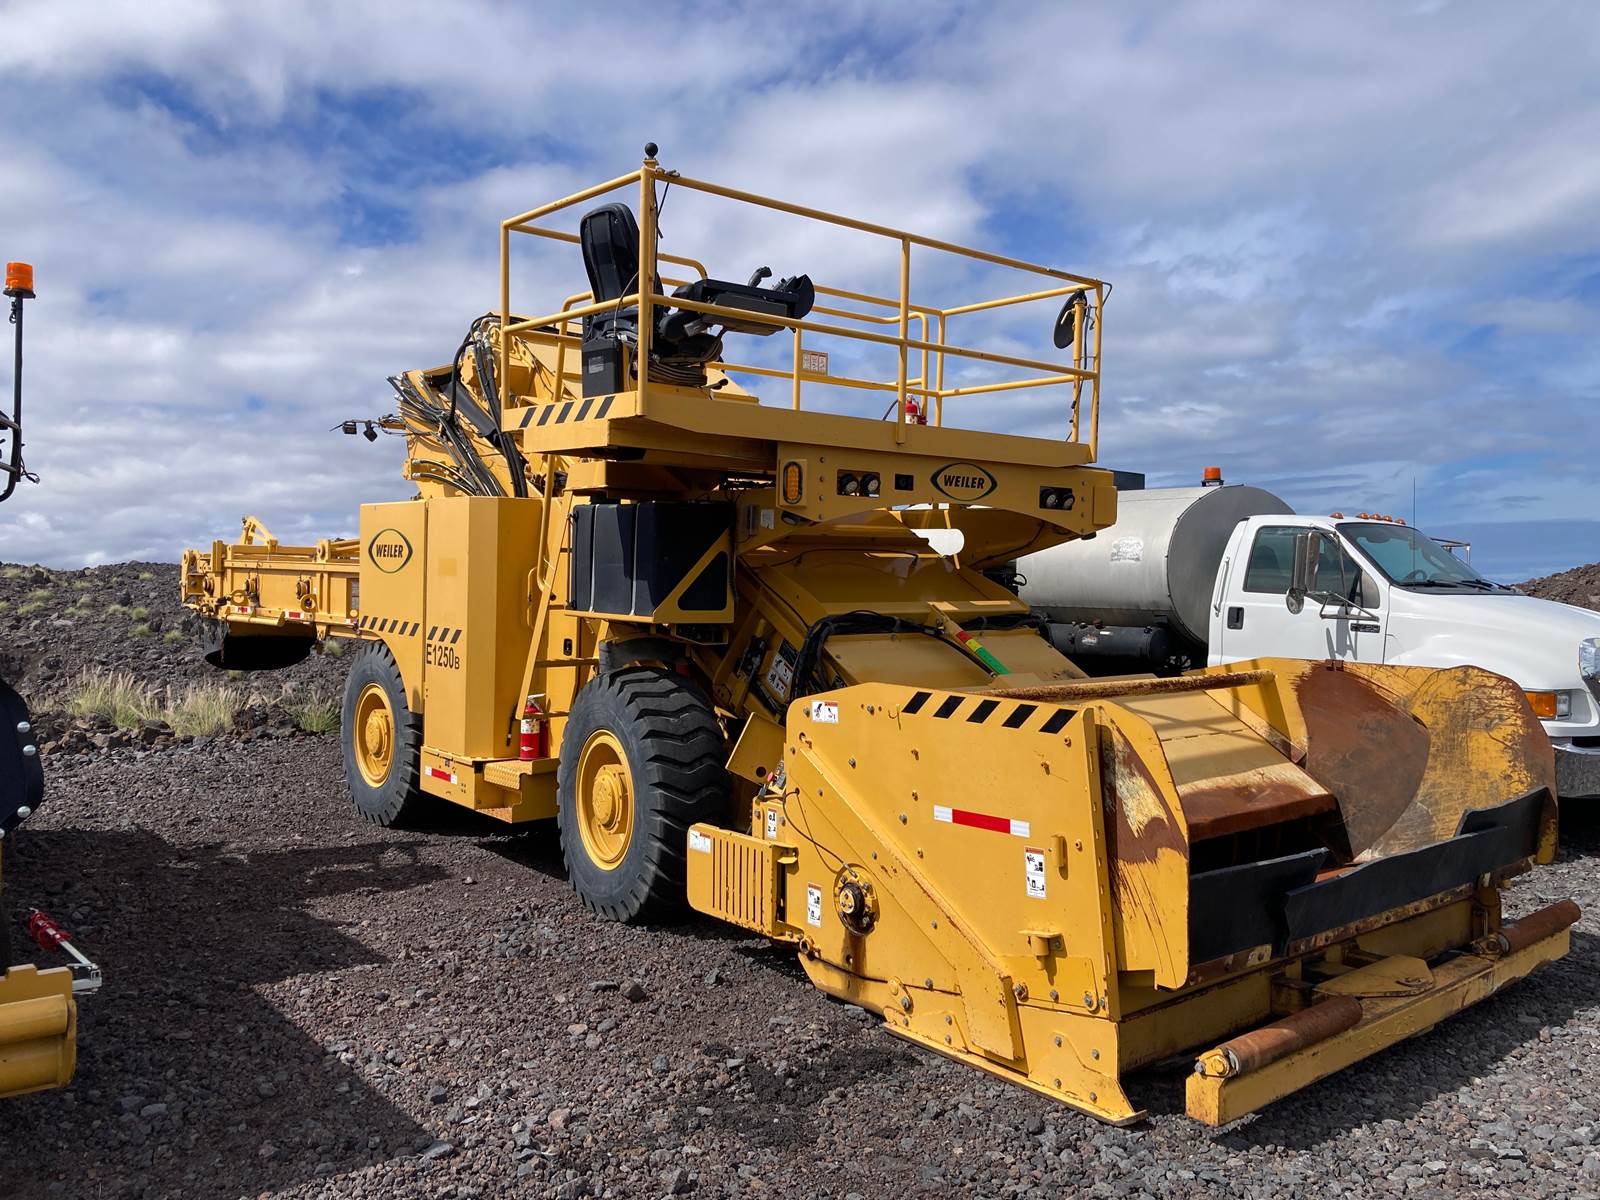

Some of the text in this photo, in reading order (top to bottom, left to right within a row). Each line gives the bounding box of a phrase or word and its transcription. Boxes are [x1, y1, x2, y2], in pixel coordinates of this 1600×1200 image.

[943, 474, 985, 489] WEILER
[376, 544, 403, 558] WEILER
[426, 644, 460, 669] E1250B
